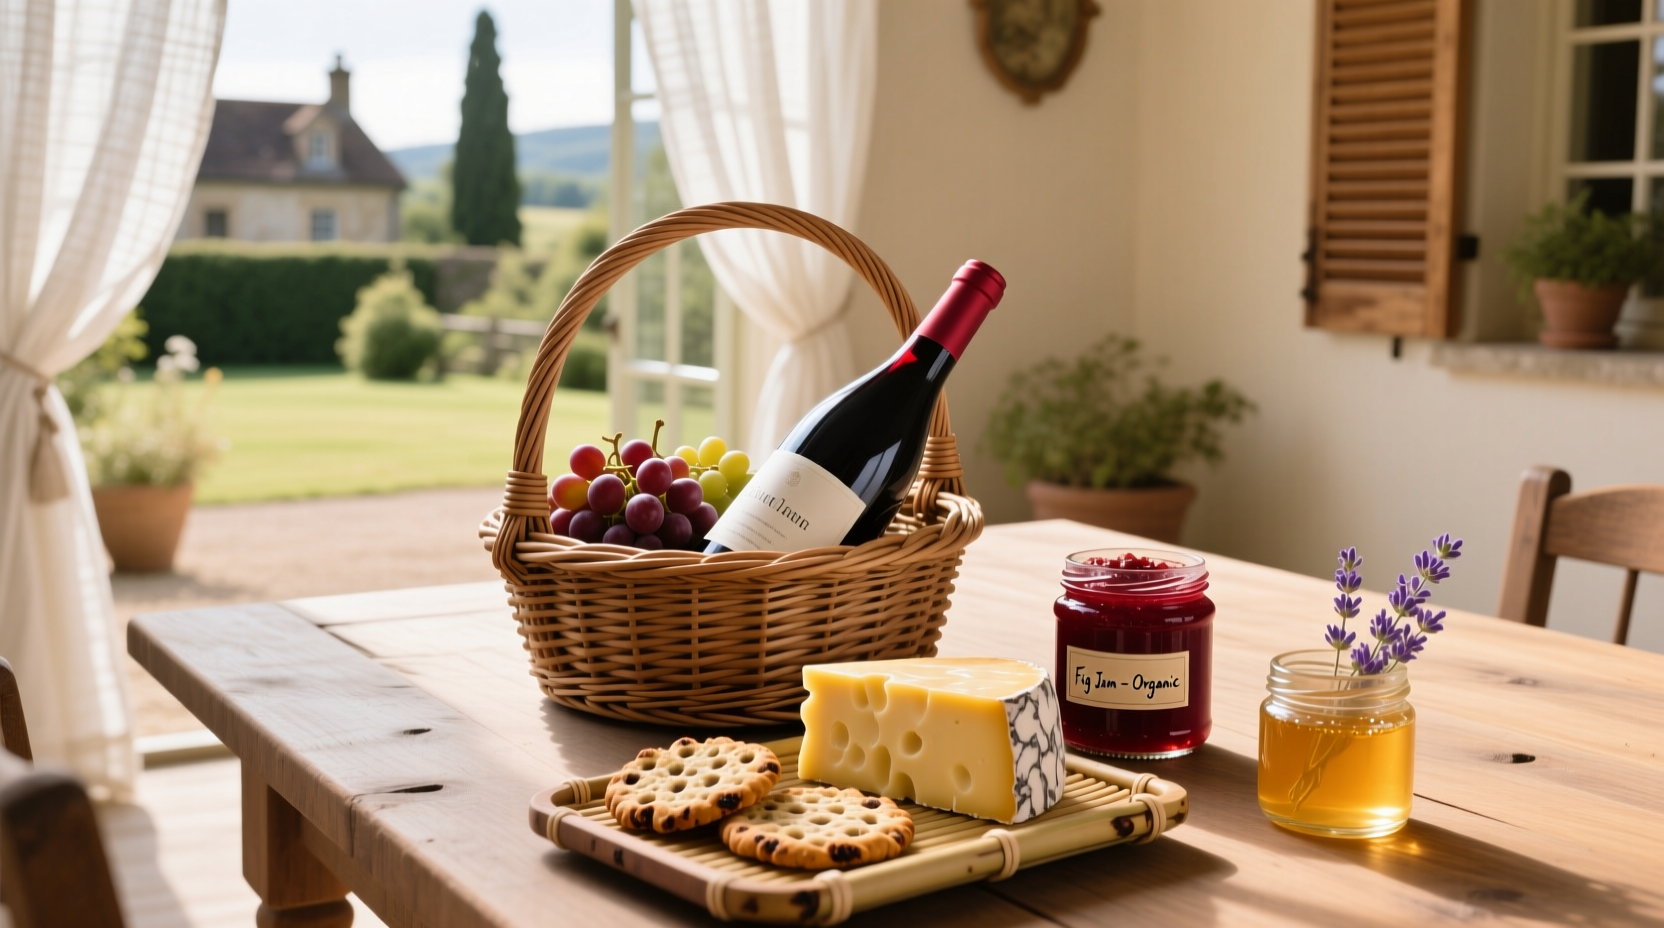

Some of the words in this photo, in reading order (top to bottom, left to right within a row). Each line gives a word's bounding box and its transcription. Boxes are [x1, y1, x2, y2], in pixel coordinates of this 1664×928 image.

[1075, 666, 1091, 694] Fig
[1095, 671, 1116, 689] Jam
[1132, 674, 1180, 699] Organic
